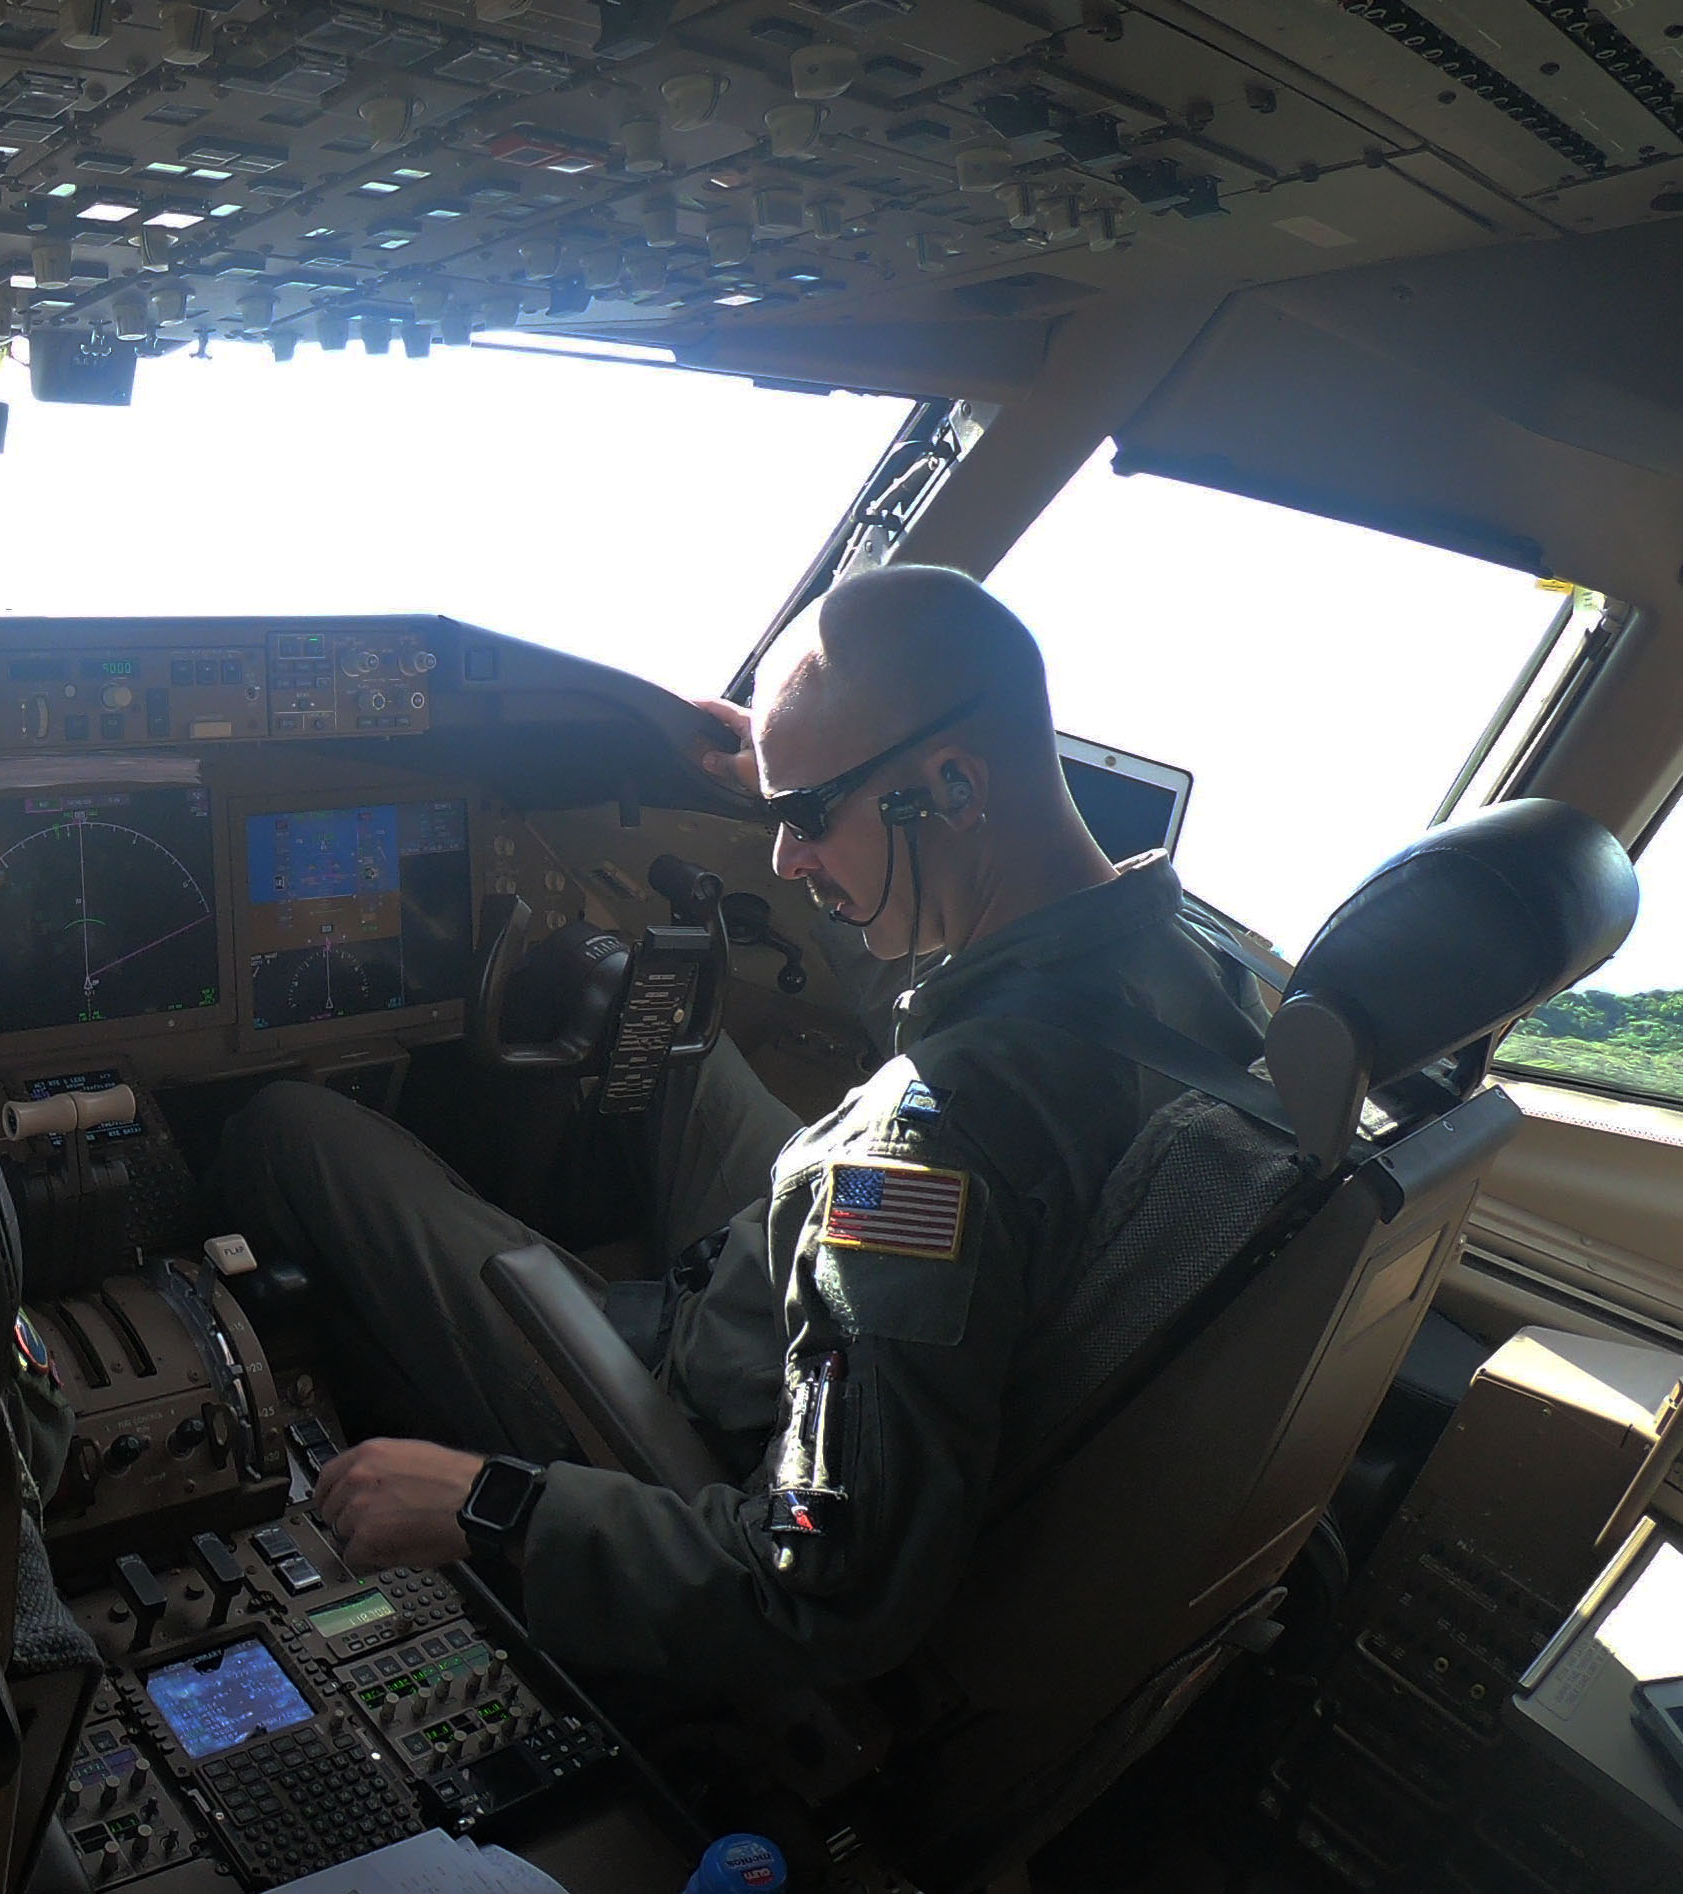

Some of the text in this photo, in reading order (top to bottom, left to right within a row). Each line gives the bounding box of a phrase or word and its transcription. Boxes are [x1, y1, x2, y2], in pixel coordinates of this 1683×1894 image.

[224, 1245, 245, 1257] FLAP
[249, 1361, 263, 1373] 20
[260, 1406, 275, 1417] 25
